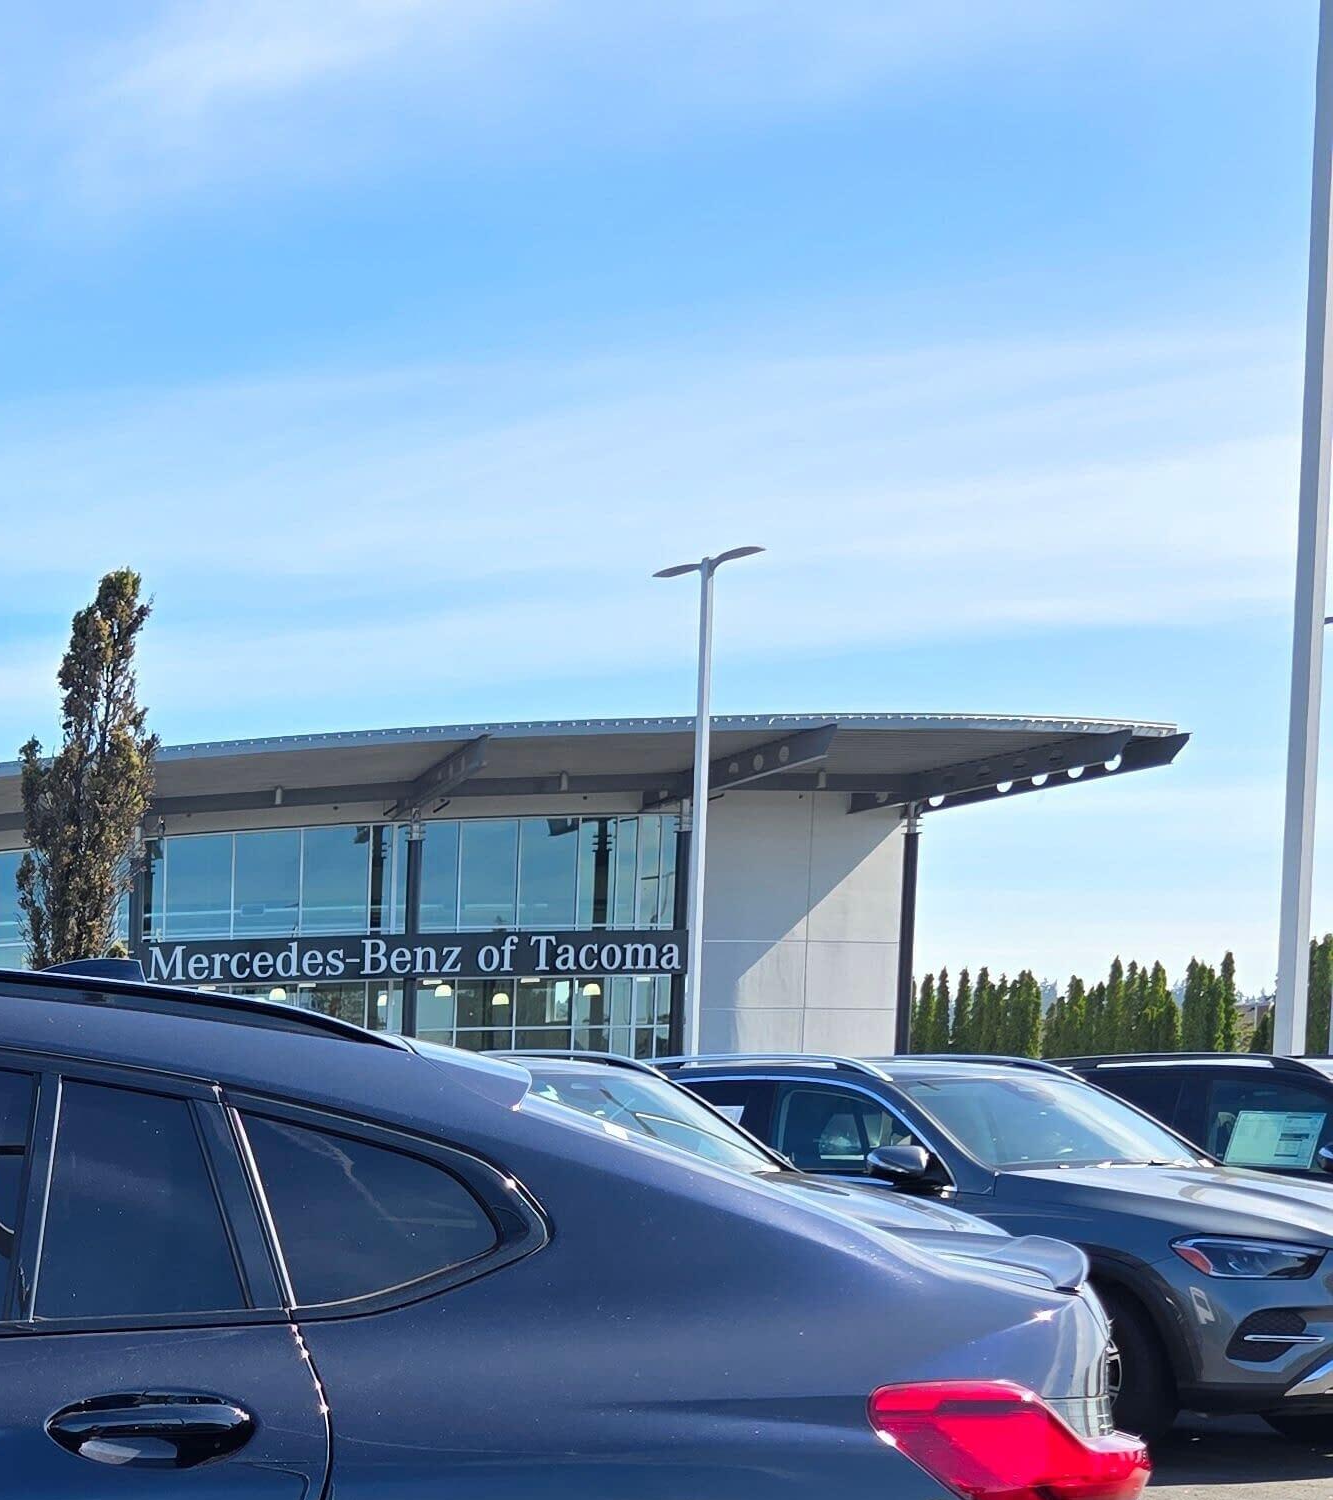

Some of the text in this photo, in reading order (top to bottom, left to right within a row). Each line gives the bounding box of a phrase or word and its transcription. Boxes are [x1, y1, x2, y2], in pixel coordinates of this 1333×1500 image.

[147, 935, 682, 982] Mercedes-Benz of Tacoma
